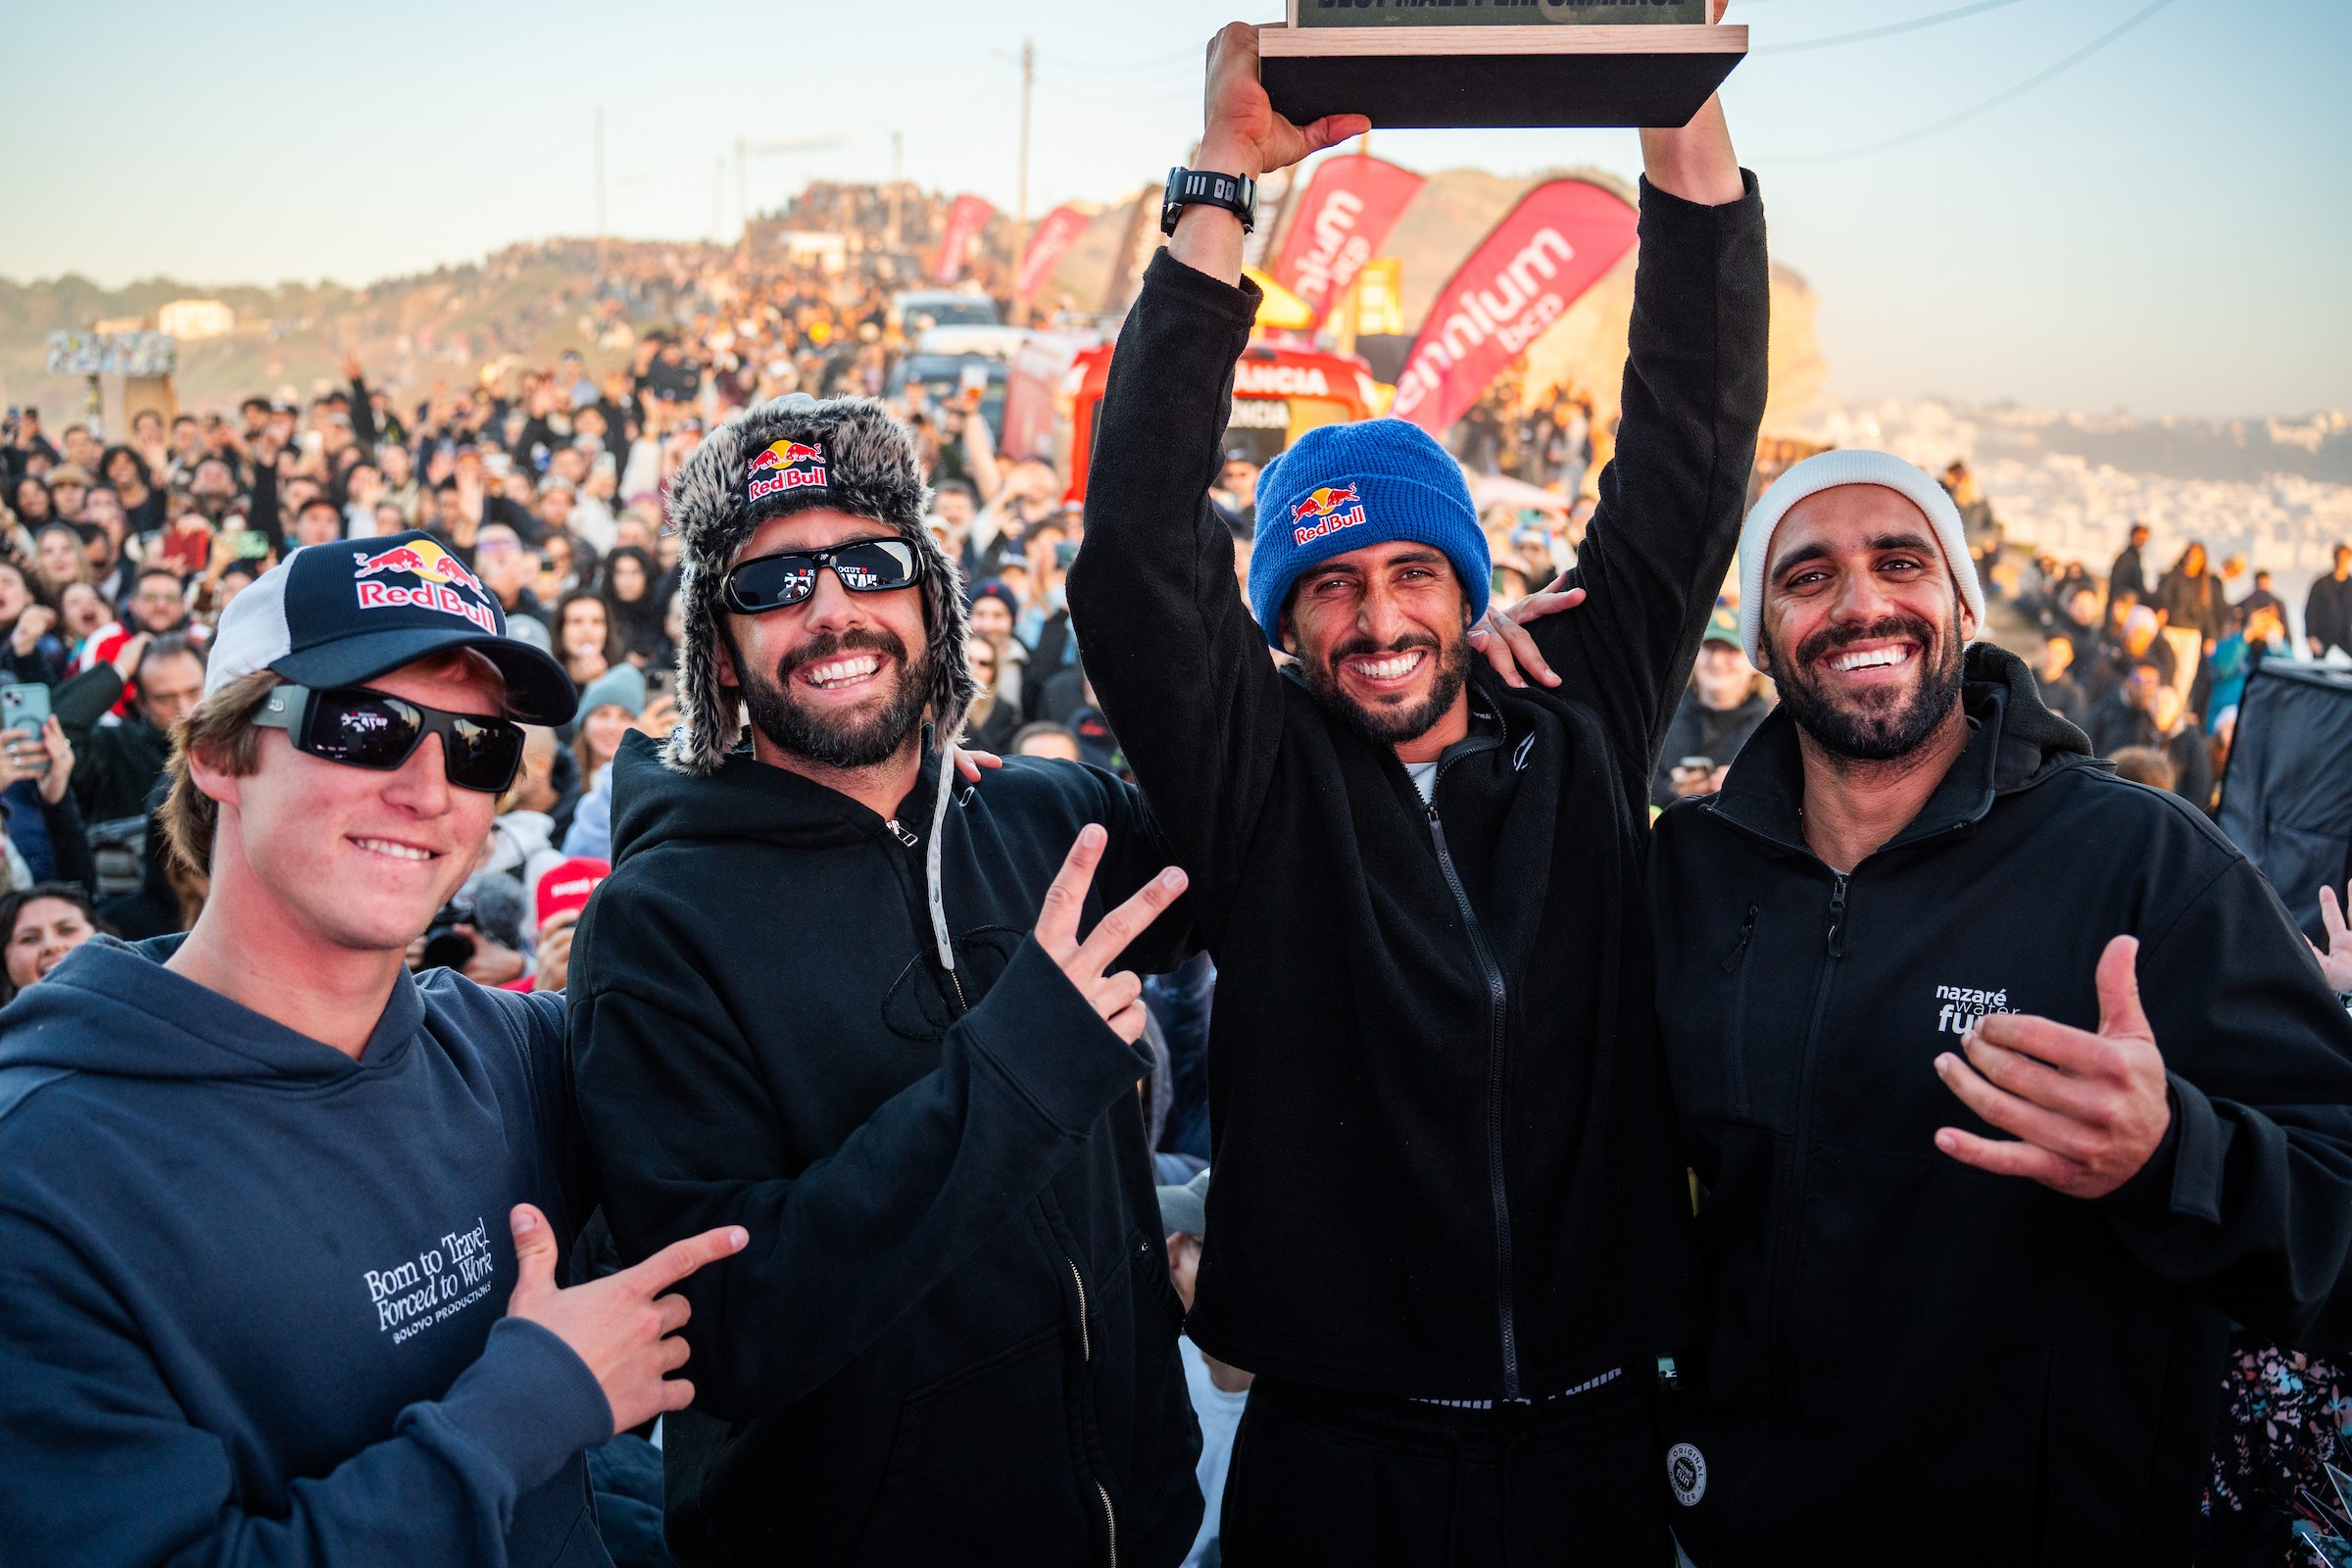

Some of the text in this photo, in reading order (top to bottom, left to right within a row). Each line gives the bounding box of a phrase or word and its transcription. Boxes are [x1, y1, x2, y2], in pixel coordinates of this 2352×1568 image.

[1294, 188, 1365, 295] nium
[1393, 226, 1575, 415] ennium
[749, 467, 825, 501] Red Bull
[1296, 507, 1364, 545] Red Bull
[359, 581, 496, 635] Red Bull
[1936, 985, 2007, 1006] nazaré
[1938, 1004, 1976, 1035] fu
[364, 1216, 490, 1302] Born to Travel
[376, 1249, 493, 1332] Forced to Work
[393, 1280, 492, 1345] BOLOVO PRODUCTIONS
[1673, 1447, 1703, 1479] ORIGINAL
[1669, 1471, 1697, 1502] PIONEER
